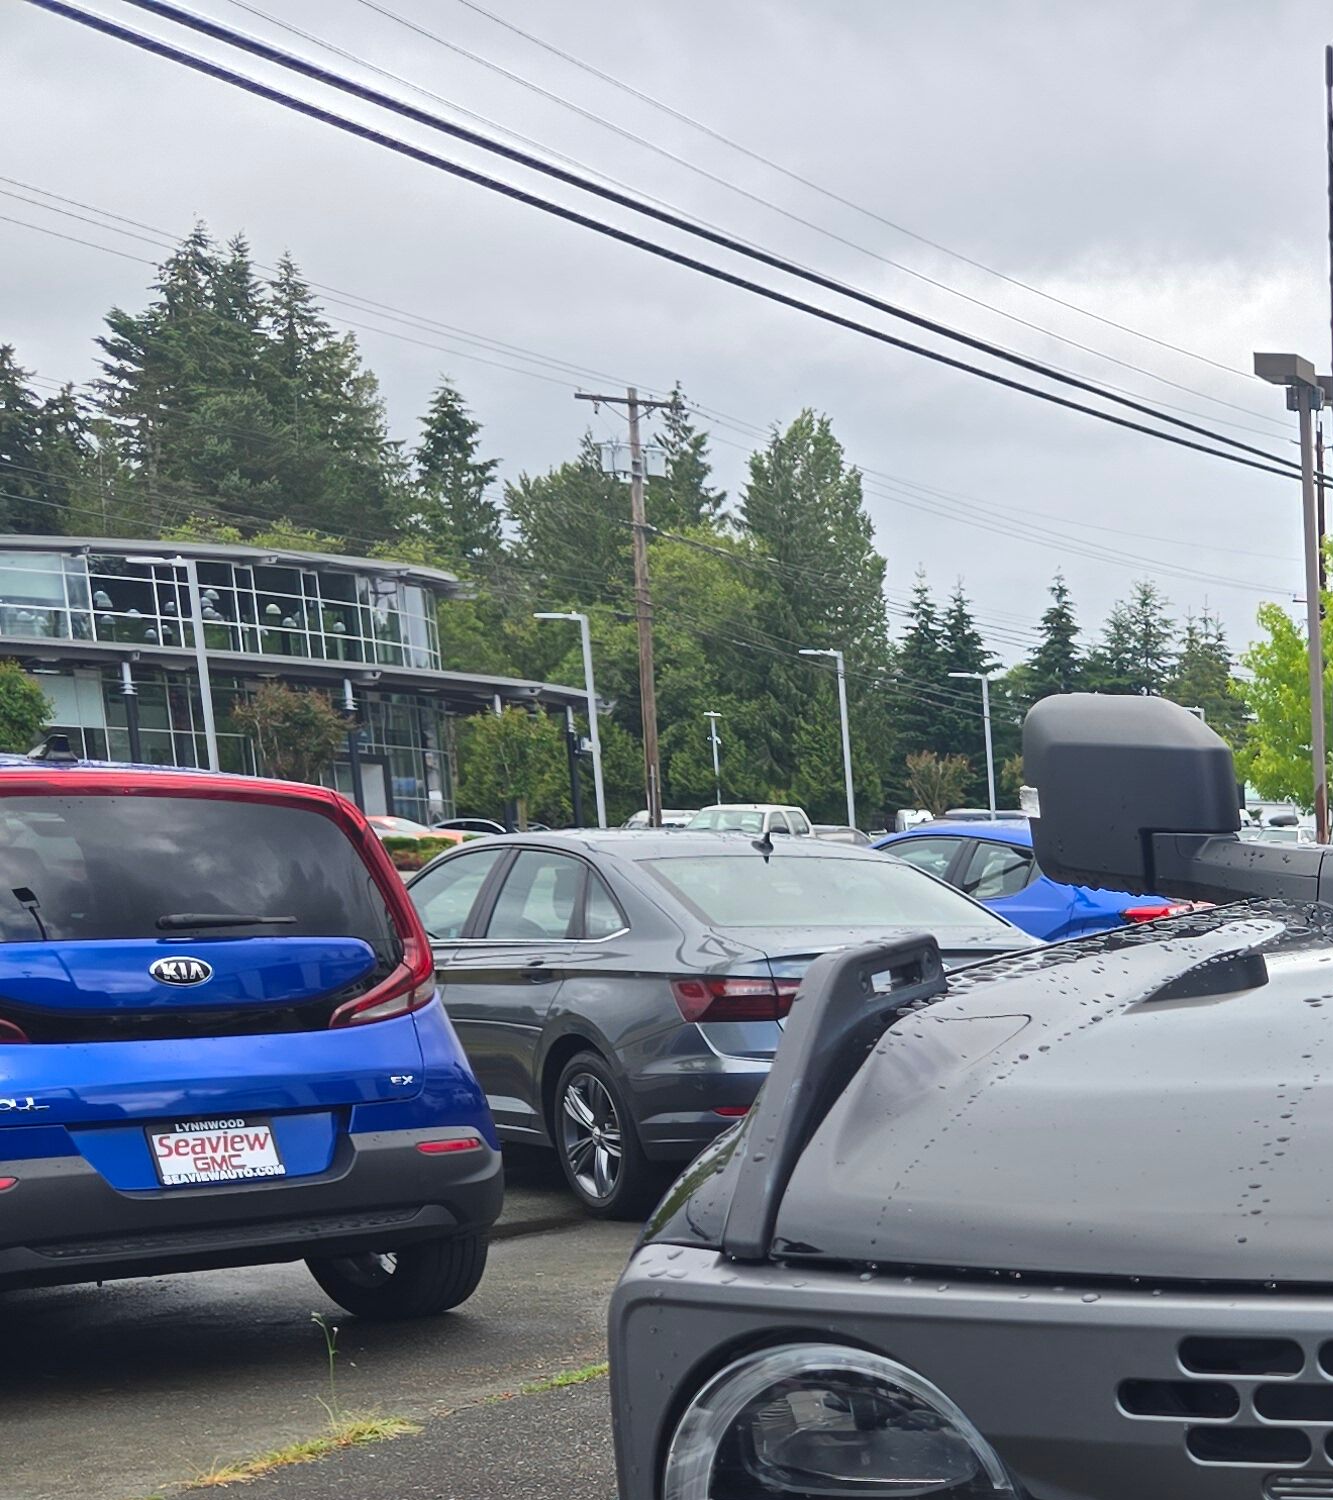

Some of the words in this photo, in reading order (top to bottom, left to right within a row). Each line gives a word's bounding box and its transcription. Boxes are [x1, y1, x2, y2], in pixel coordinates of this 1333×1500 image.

[160, 961, 205, 980] KIA
[391, 1075, 414, 1086] EX
[174, 1119, 246, 1132] LYNNWOOD
[158, 1131, 271, 1158] Seaview
[193, 1153, 247, 1172] GMC
[162, 1164, 286, 1185] SEAVIEWAUTO.COM
